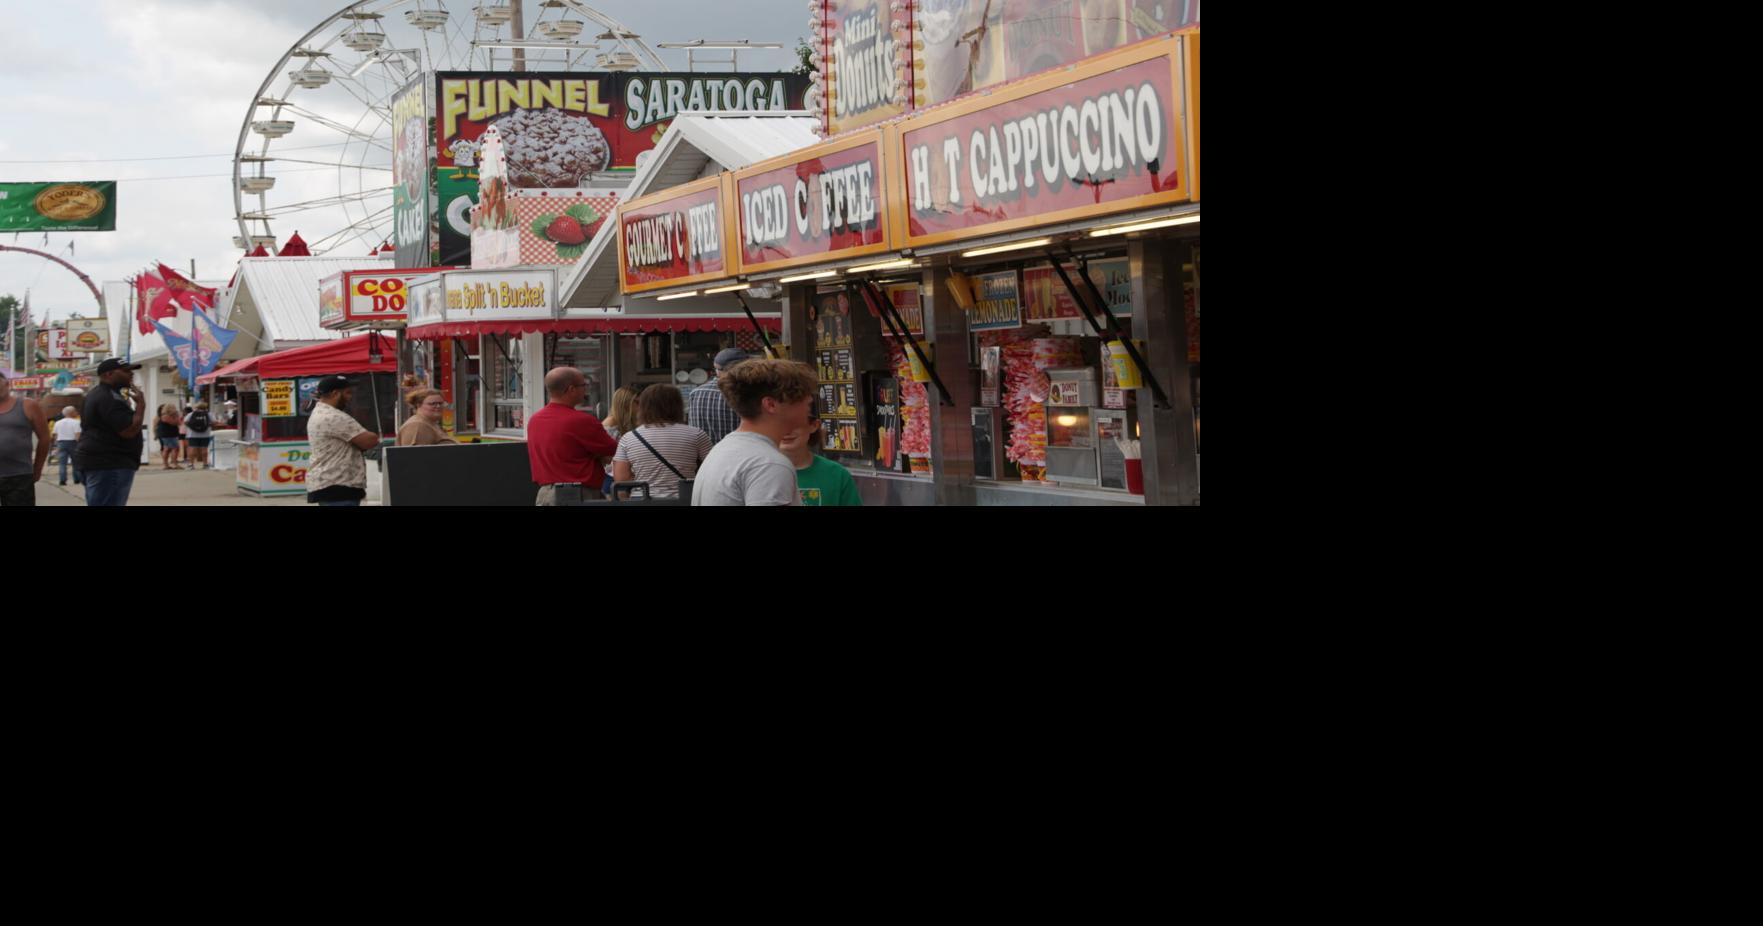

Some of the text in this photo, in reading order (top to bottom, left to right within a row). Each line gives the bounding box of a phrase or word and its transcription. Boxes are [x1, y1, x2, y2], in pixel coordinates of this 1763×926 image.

[844, 9, 877, 45] Mini
[834, 30, 895, 118] Donuts
[442, 78, 610, 140] FUNNEL
[625, 77, 787, 131] SARATOGA
[970, 83, 1161, 198] CAPPUCCINO
[742, 185, 788, 246] ICED
[626, 212, 673, 268] GOURMET
[357, 277, 415, 296] CO
[463, 282, 486, 316] Split
[500, 281, 546, 308] Bucket
[983, 275, 1015, 297] FROZEN
[970, 299, 1019, 325] LEMONADE
[262, 386, 294, 394] Candy
